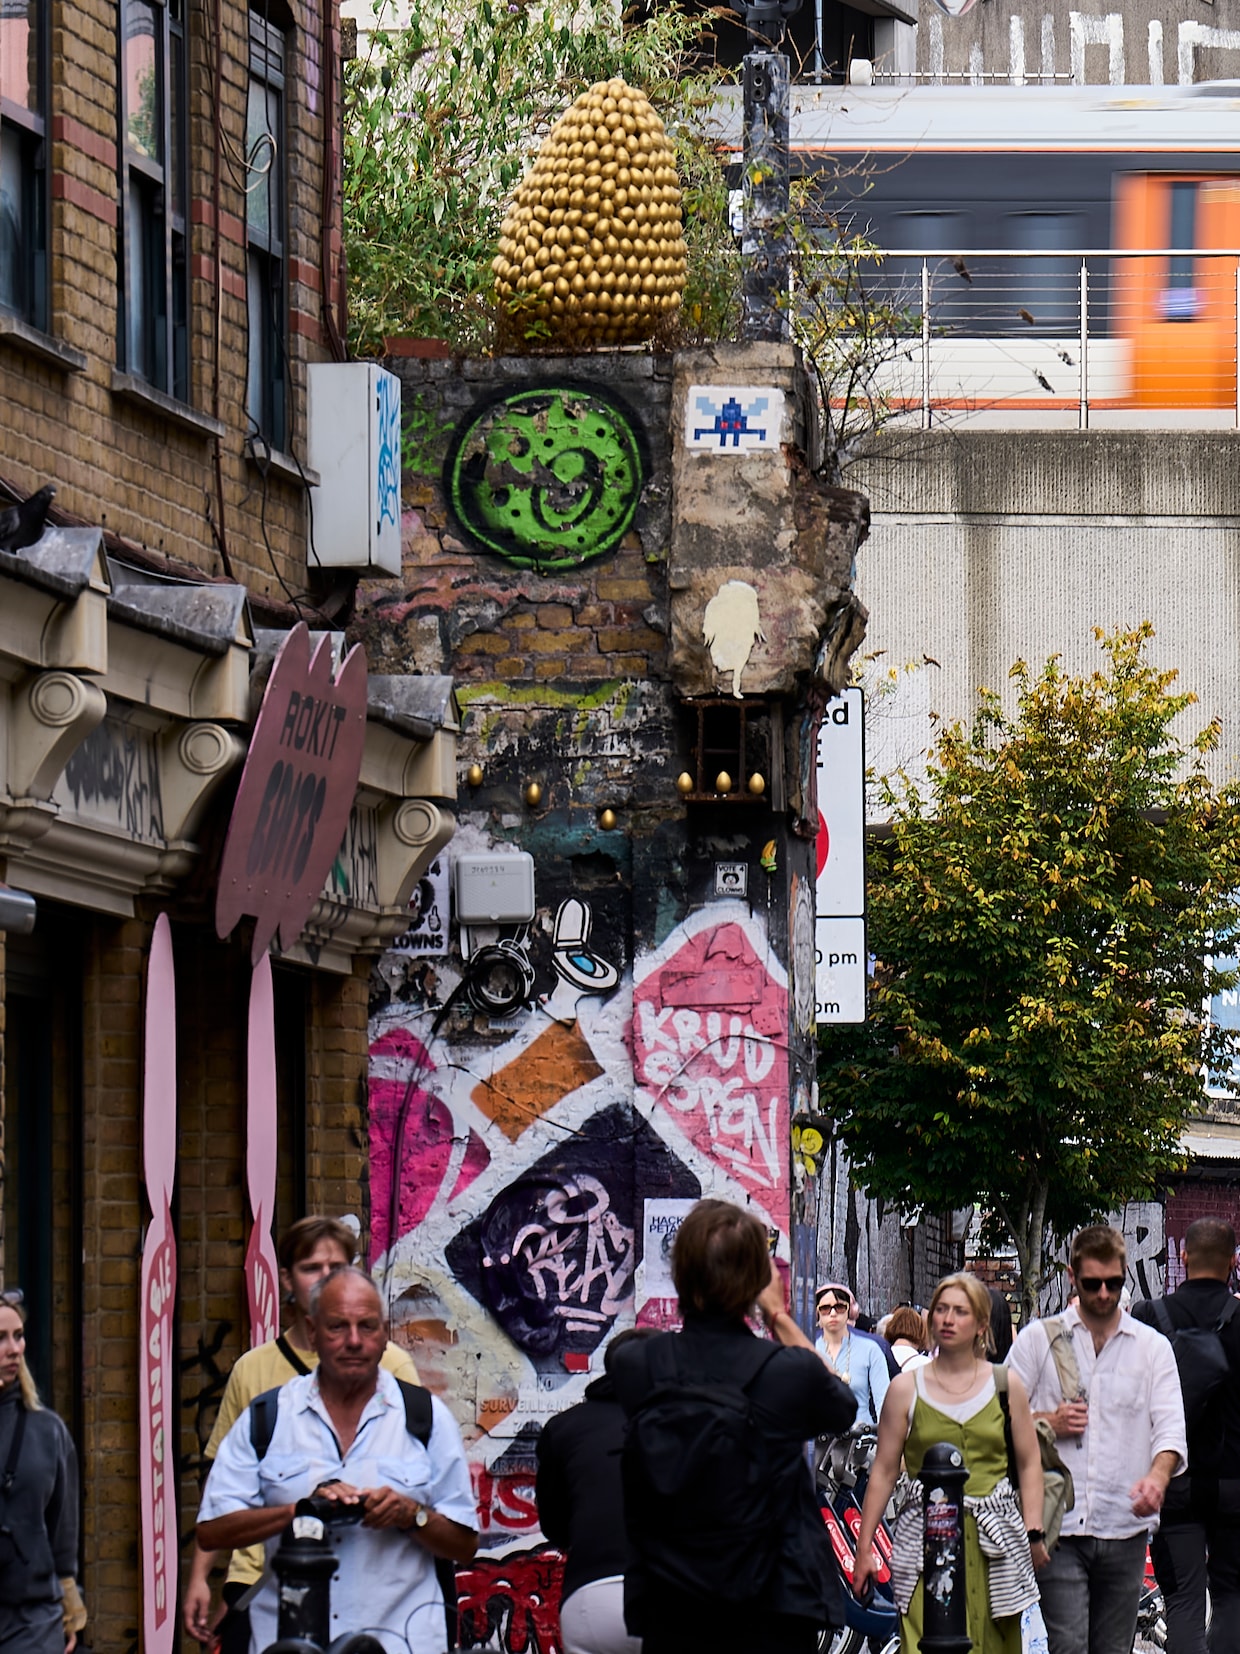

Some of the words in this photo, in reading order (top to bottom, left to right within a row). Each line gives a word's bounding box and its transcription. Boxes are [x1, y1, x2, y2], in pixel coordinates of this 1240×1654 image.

[280, 690, 347, 760] ROKIT
[717, 886, 744, 894] CLOWNS
[392, 934, 444, 950] LOWNS
[829, 953, 857, 968] pm
[652, 1216, 684, 1225] HACK
[649, 1223, 677, 1234] PETA
[480, 1397, 577, 1414] SURVEILLAN
[149, 1246, 172, 1611] SUSTAINABLE
